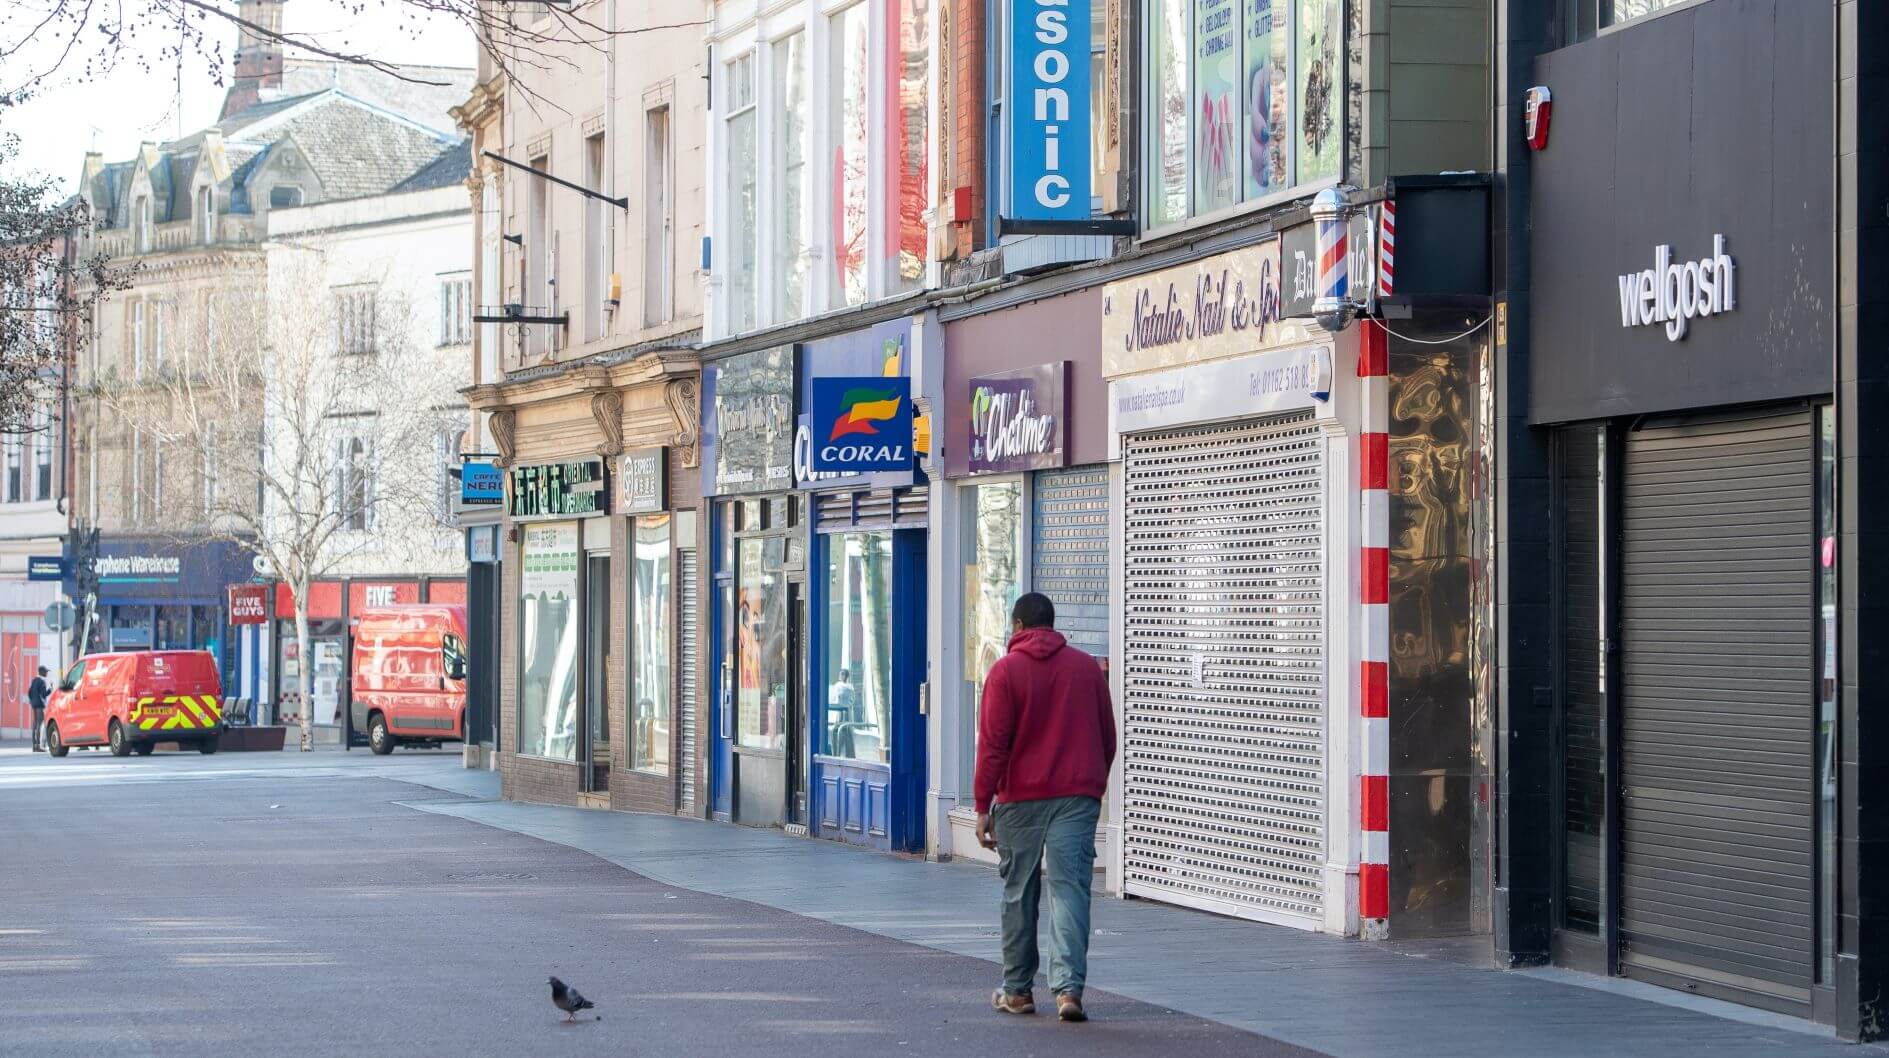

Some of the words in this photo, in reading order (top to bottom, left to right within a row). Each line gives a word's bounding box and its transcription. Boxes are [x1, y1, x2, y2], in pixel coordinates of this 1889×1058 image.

[1033, 0, 1070, 208] sonic
[1618, 233, 1735, 342] wellgosh
[1126, 282, 1183, 352] Natalie
[1186, 269, 1228, 340] Nail
[1231, 280, 1249, 331] &
[1250, 373, 1261, 397] Tel:
[986, 389, 1047, 463] Chatime
[821, 445, 905, 462] CORAL
[563, 461, 593, 485] ORIENTAL
[88, 555, 130, 577] arphone
[235, 596, 262, 607] FIVE
[366, 585, 395, 607] FIVE
[232, 606, 265, 617] GUYS
